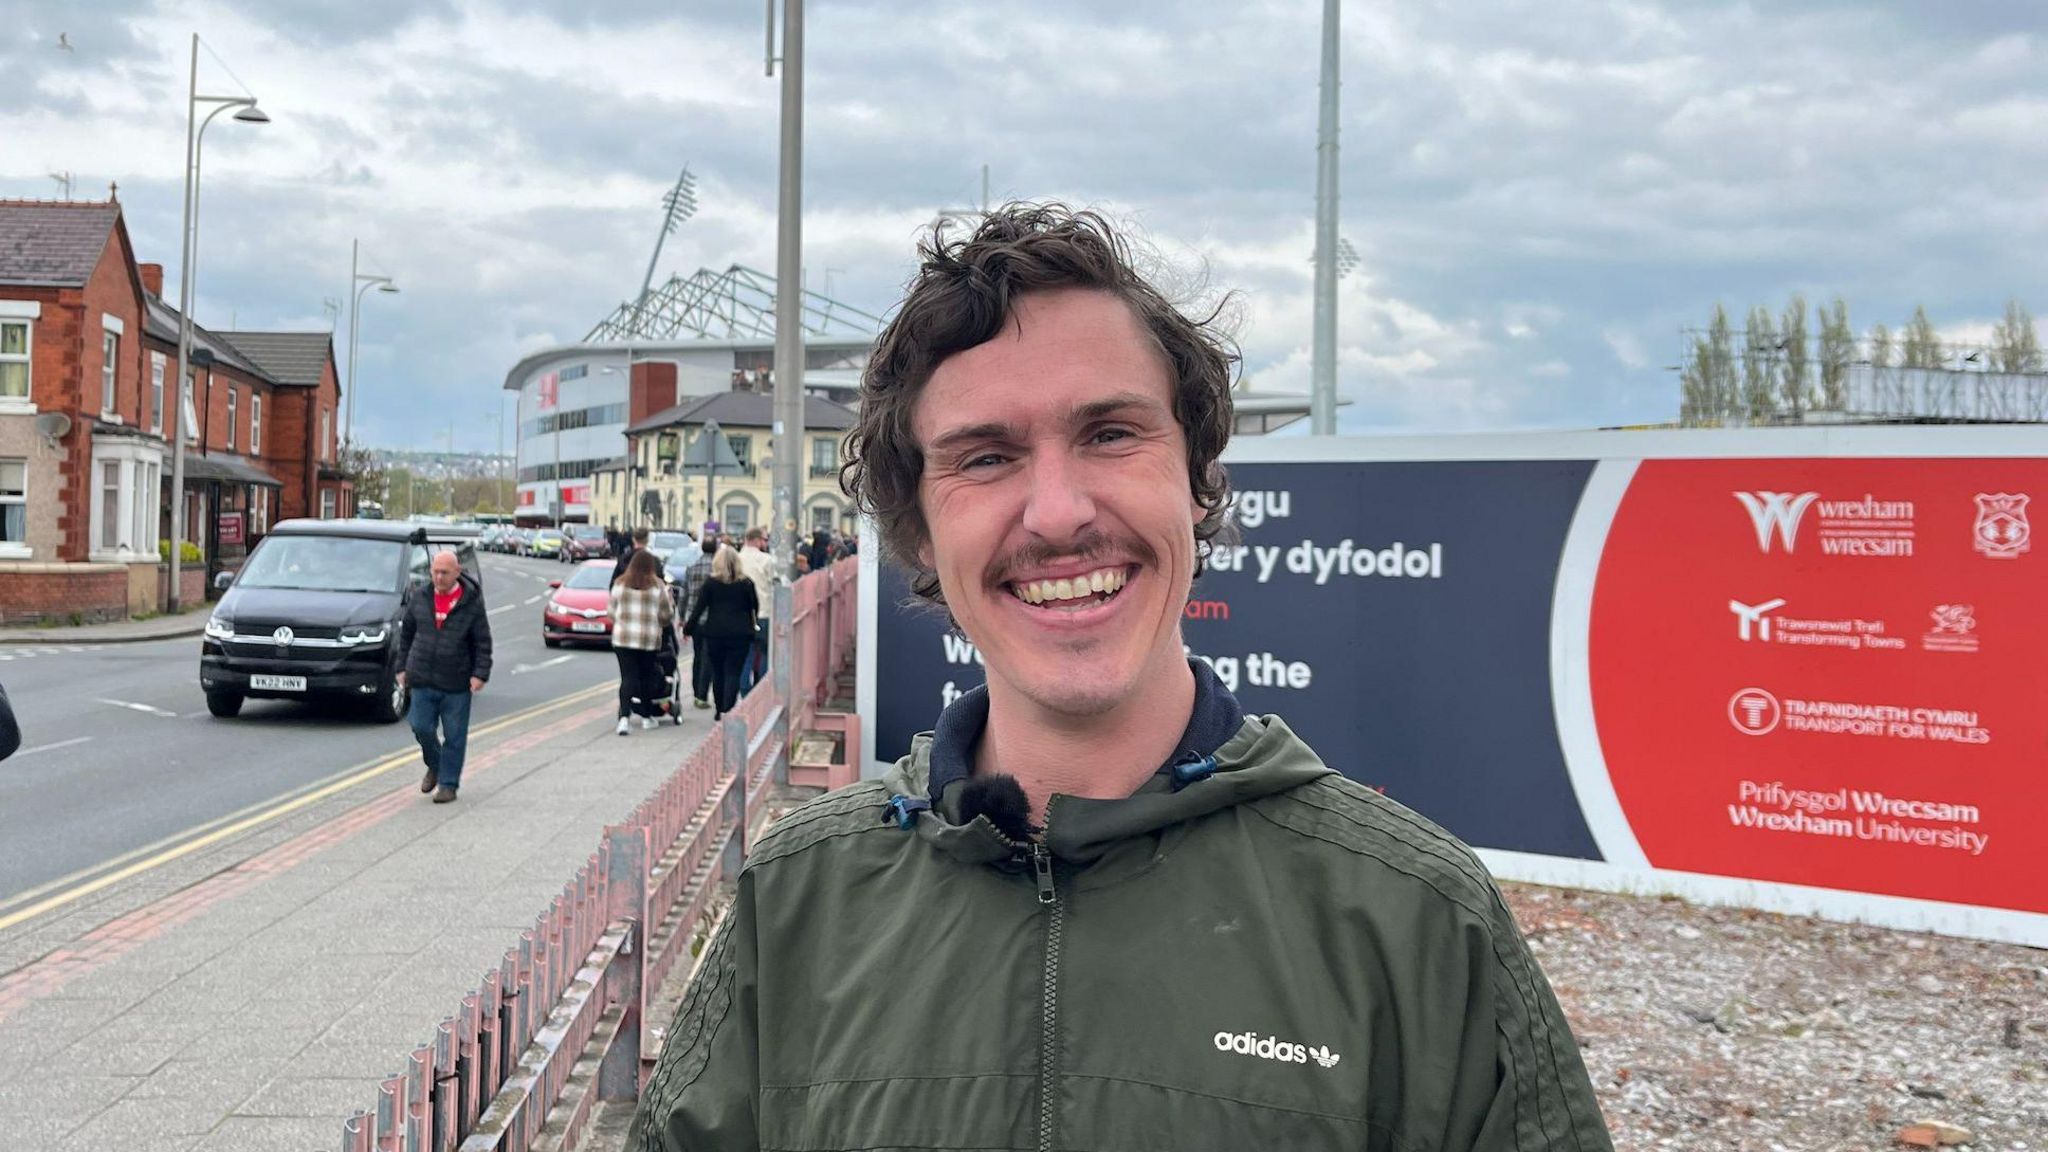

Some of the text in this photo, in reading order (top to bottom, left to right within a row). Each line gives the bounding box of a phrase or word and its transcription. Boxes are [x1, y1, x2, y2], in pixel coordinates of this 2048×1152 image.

[1222, 490, 1290, 528] ygu
[1817, 493, 1914, 519] wrexham
[1254, 546, 1281, 583] y
[1286, 539, 1442, 585] dyfodol
[1821, 538, 1913, 557] wrecsam
[1185, 600, 1230, 620] am
[1776, 616, 1885, 634] Trawsnewid Trefi
[1776, 630, 1906, 650] Transforming Towns
[1246, 652, 1312, 690] the
[1785, 700, 1978, 727] TRAFNIDIAETH CYMRU
[1785, 715, 1991, 745] TRANSPORT FOR WALES
[1739, 780, 1980, 824] Prifysgol Wrecsam
[1728, 804, 1989, 856] Wrexham University
[1214, 1031, 1307, 1064] adidas
